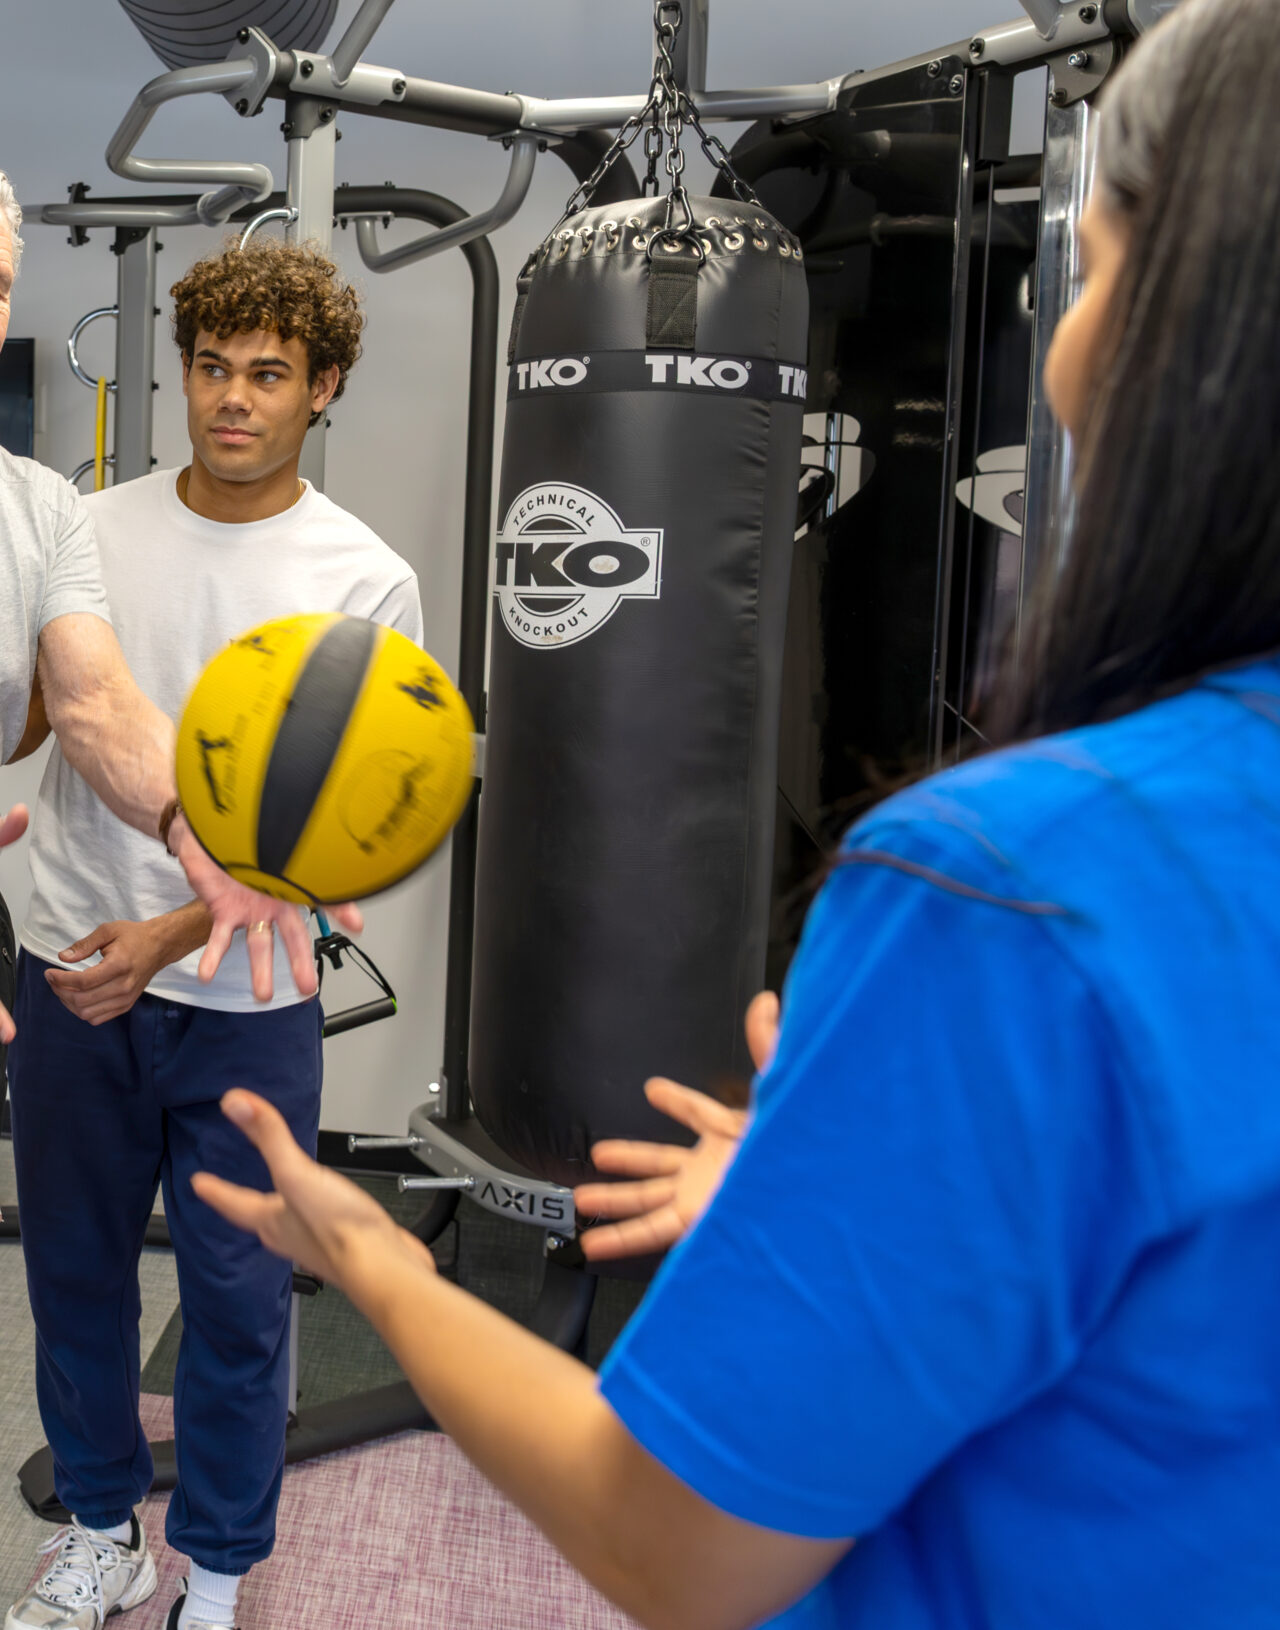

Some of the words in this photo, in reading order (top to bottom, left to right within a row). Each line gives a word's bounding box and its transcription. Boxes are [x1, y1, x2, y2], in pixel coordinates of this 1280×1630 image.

[778, 365, 807, 400] TK
[513, 493, 597, 527] TECHNICAL
[509, 607, 589, 637] KNOCKOUT
[481, 1181, 565, 1220] AXIS
